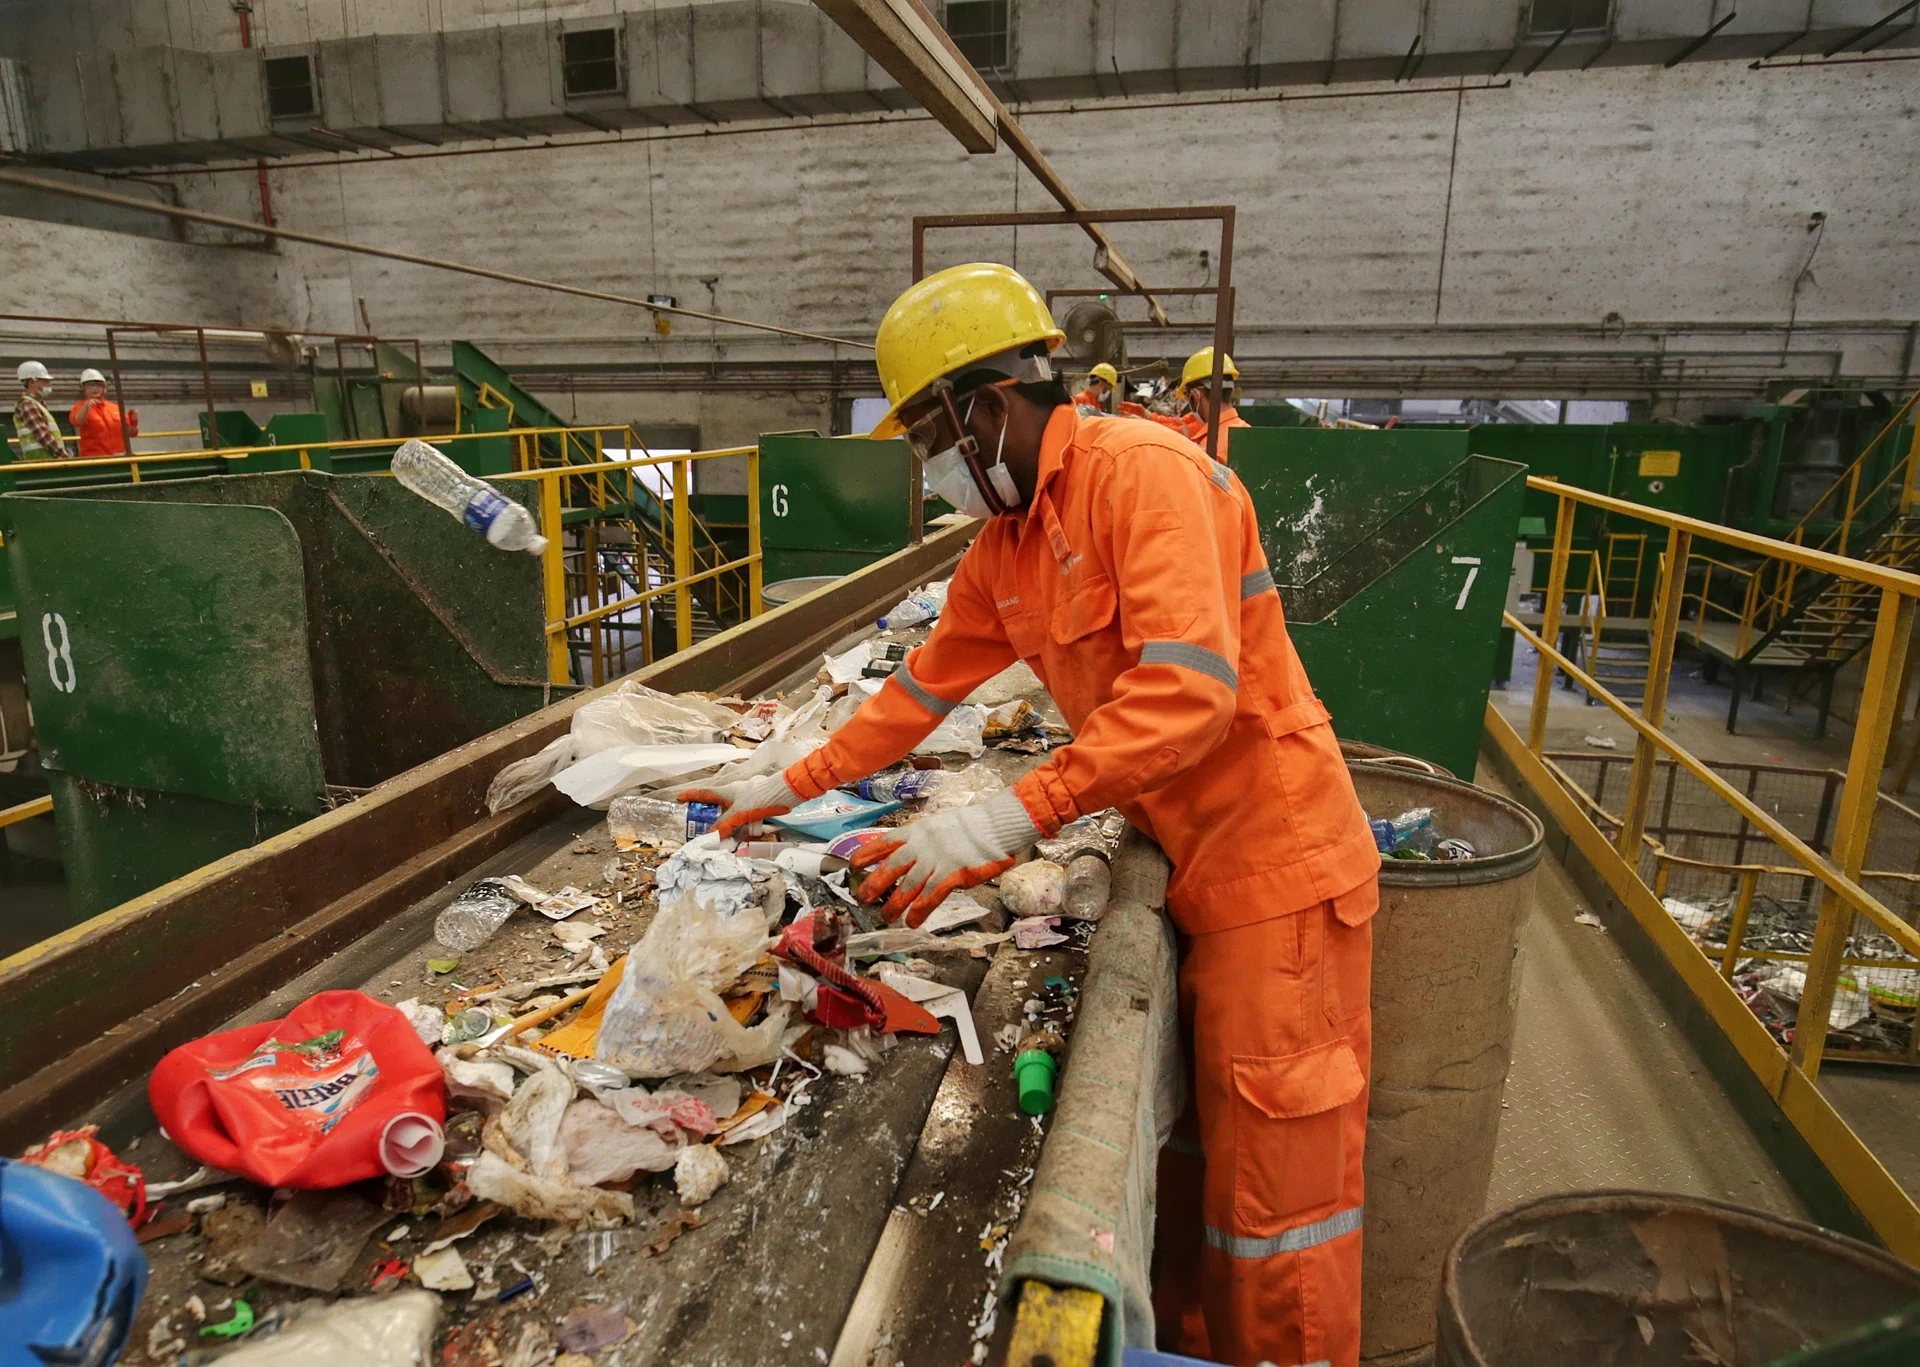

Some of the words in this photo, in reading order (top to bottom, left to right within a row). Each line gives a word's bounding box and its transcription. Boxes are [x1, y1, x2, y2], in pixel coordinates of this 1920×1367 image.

[202, 427, 210, 440] 2
[268, 433, 276, 447] 3
[772, 484, 789, 517] 6
[1451, 556, 1481, 610] 7
[42, 613, 76, 693] 8
[274, 1073, 358, 1110] BREEZE
